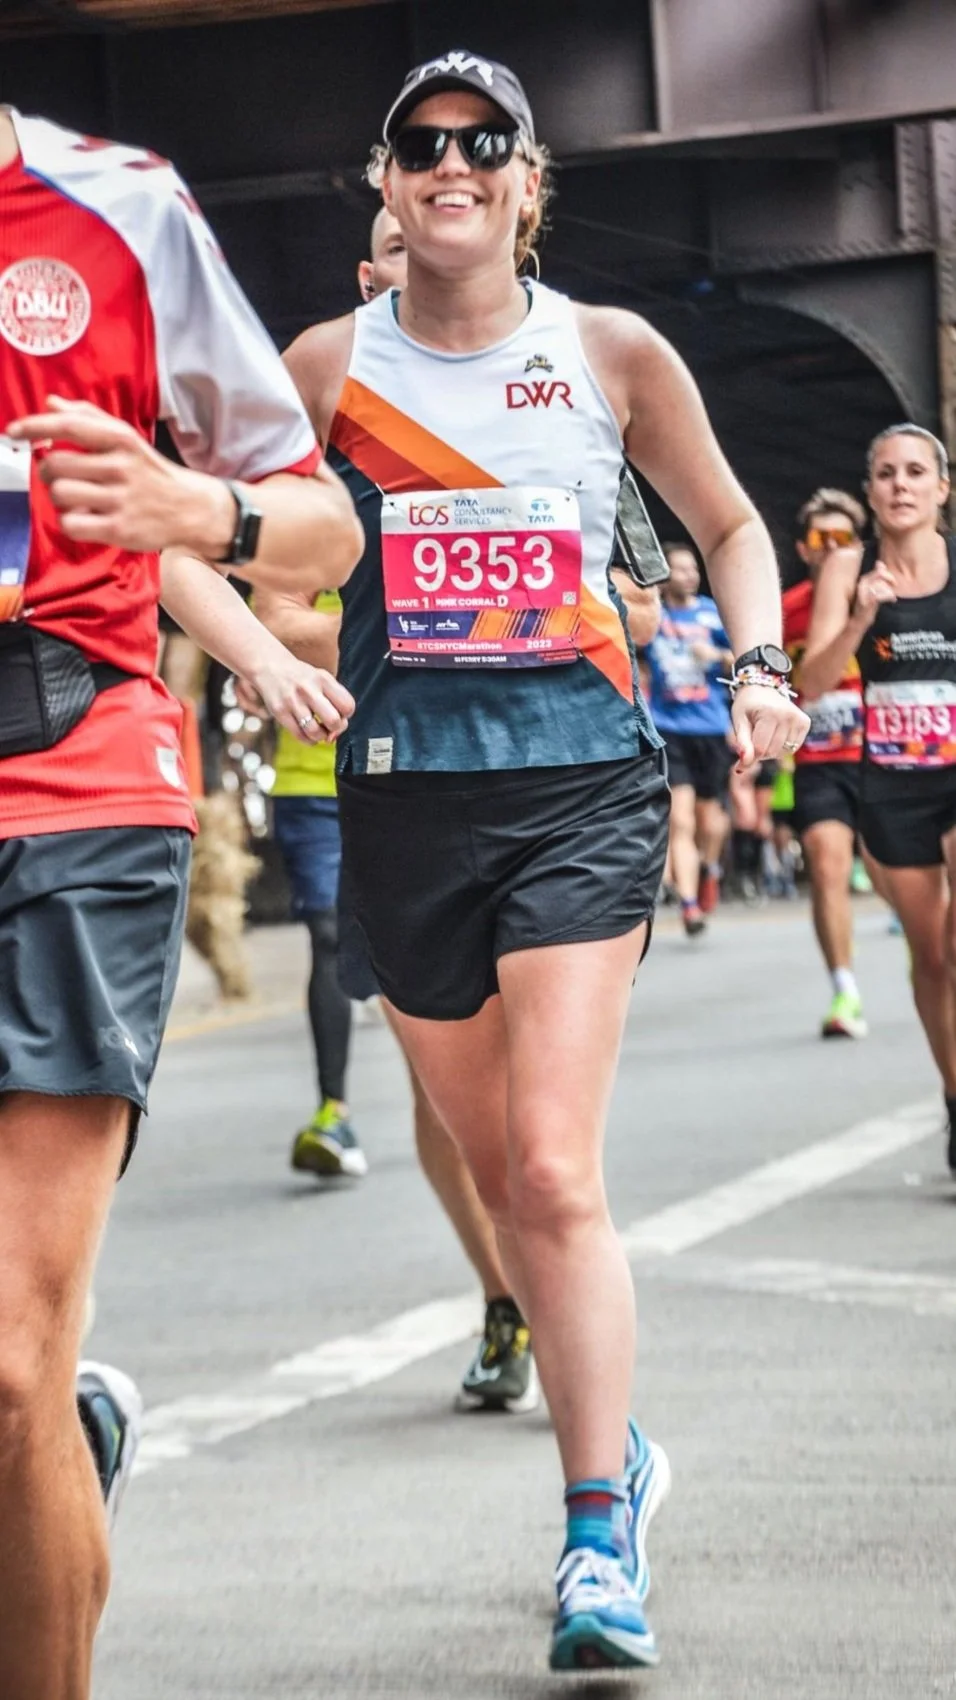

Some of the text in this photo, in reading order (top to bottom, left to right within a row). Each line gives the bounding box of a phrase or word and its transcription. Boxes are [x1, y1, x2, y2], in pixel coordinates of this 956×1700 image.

[15, 289, 68, 318] DBU
[506, 380, 574, 410] DWR
[454, 498, 479, 507] TATA
[408, 501, 450, 526] tcs
[527, 514, 555, 524] TATA
[412, 535, 555, 592] 9353
[392, 598, 419, 608] WAVE
[422, 596, 430, 609] 1
[458, 597, 497, 607] CORRAL
[497, 594, 509, 608] D
[526, 638, 553, 649] 2023
